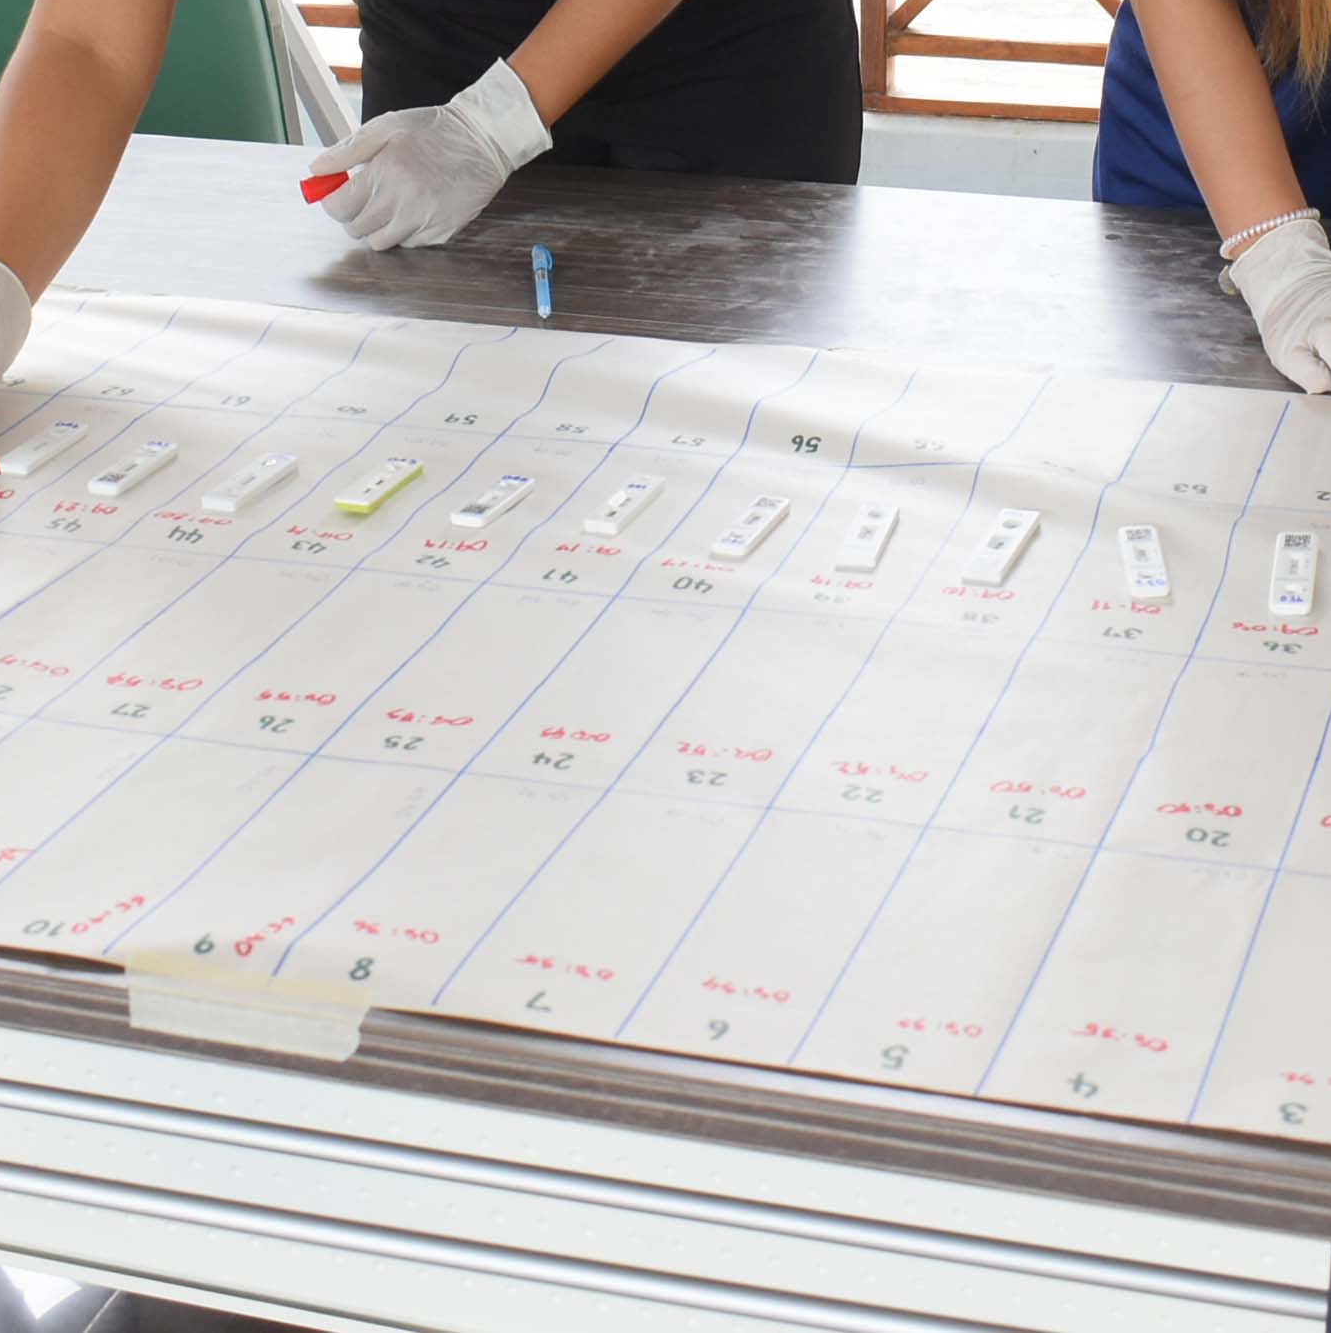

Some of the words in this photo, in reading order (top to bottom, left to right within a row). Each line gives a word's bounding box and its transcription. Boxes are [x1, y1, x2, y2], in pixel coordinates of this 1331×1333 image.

[100, 385, 136, 399] 62
[220, 395, 253, 408] 61
[443, 413, 479, 426] 59
[790, 434, 822, 454] 56
[1173, 482, 1209, 496] 53
[45, 517, 83, 534] 45
[167, 525, 204, 545] 44
[291, 538, 328, 556] 43
[414, 554, 451, 570] 42
[541, 568, 579, 584] 41
[671, 575, 714, 594] 40
[1102, 626, 1144, 641] 37
[1262, 640, 1303, 655] 36
[110, 702, 152, 719] 27
[259, 715, 295, 734] 26
[383, 735, 425, 752] 25
[531, 751, 575, 771] 24
[686, 769, 728, 787] 23
[840, 783, 885, 804] 22
[1008, 804, 1047, 826] 21
[1185, 826, 1231, 848] 20
[21, 918, 66, 938] 10
[192, 934, 216, 956] 9
[347, 957, 375, 982] 8
[523, 990, 552, 1013] 7
[707, 1019, 730, 1041] 6
[880, 1044, 909, 1071] 5
[1068, 1072, 1100, 1099] 4
[1278, 1102, 1308, 1126] 3
